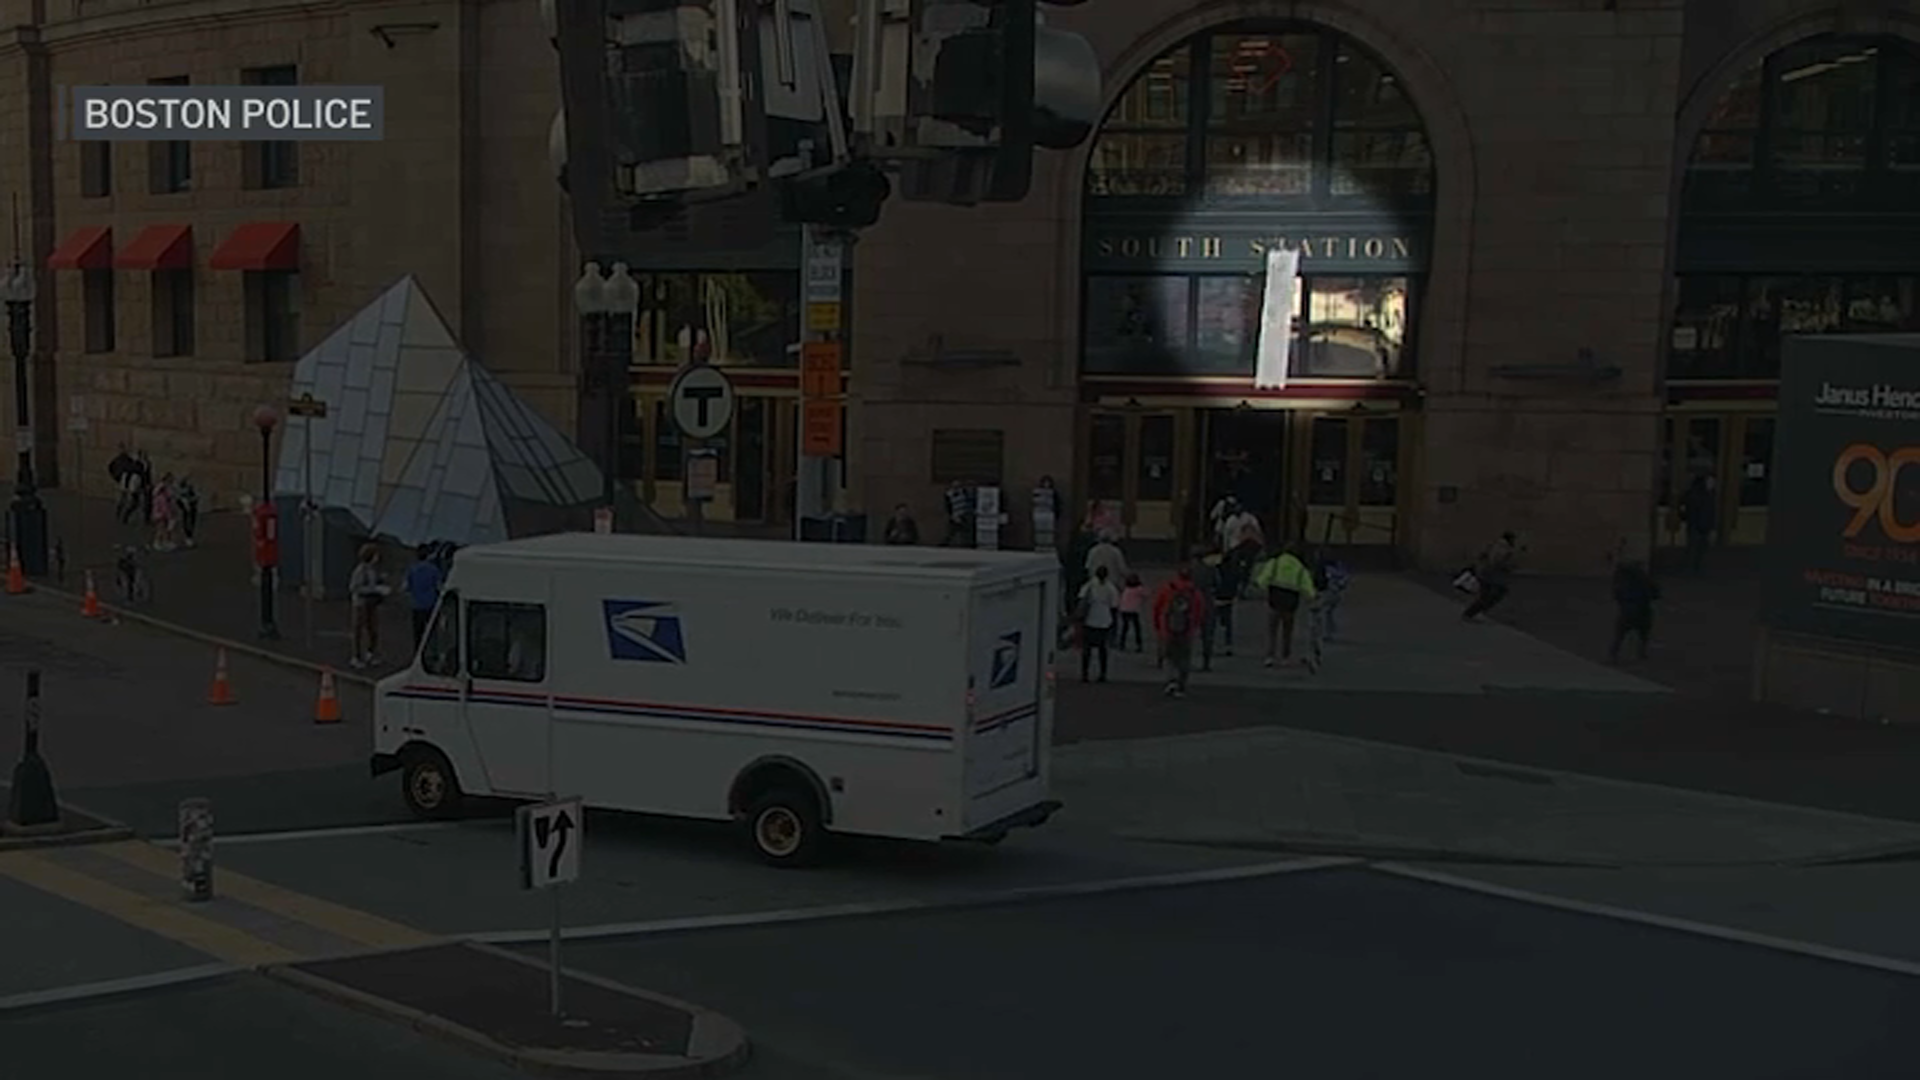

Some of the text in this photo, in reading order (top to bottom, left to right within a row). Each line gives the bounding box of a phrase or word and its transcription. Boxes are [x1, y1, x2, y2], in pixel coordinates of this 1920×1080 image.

[1097, 236, 1411, 260] SOUTH STATION
[1816, 382, 1869, 405] Janus
[683, 386, 723, 427] T
[769, 607, 793, 621] We
[795, 609, 846, 625] Deliver
[848, 612, 871, 627] For
